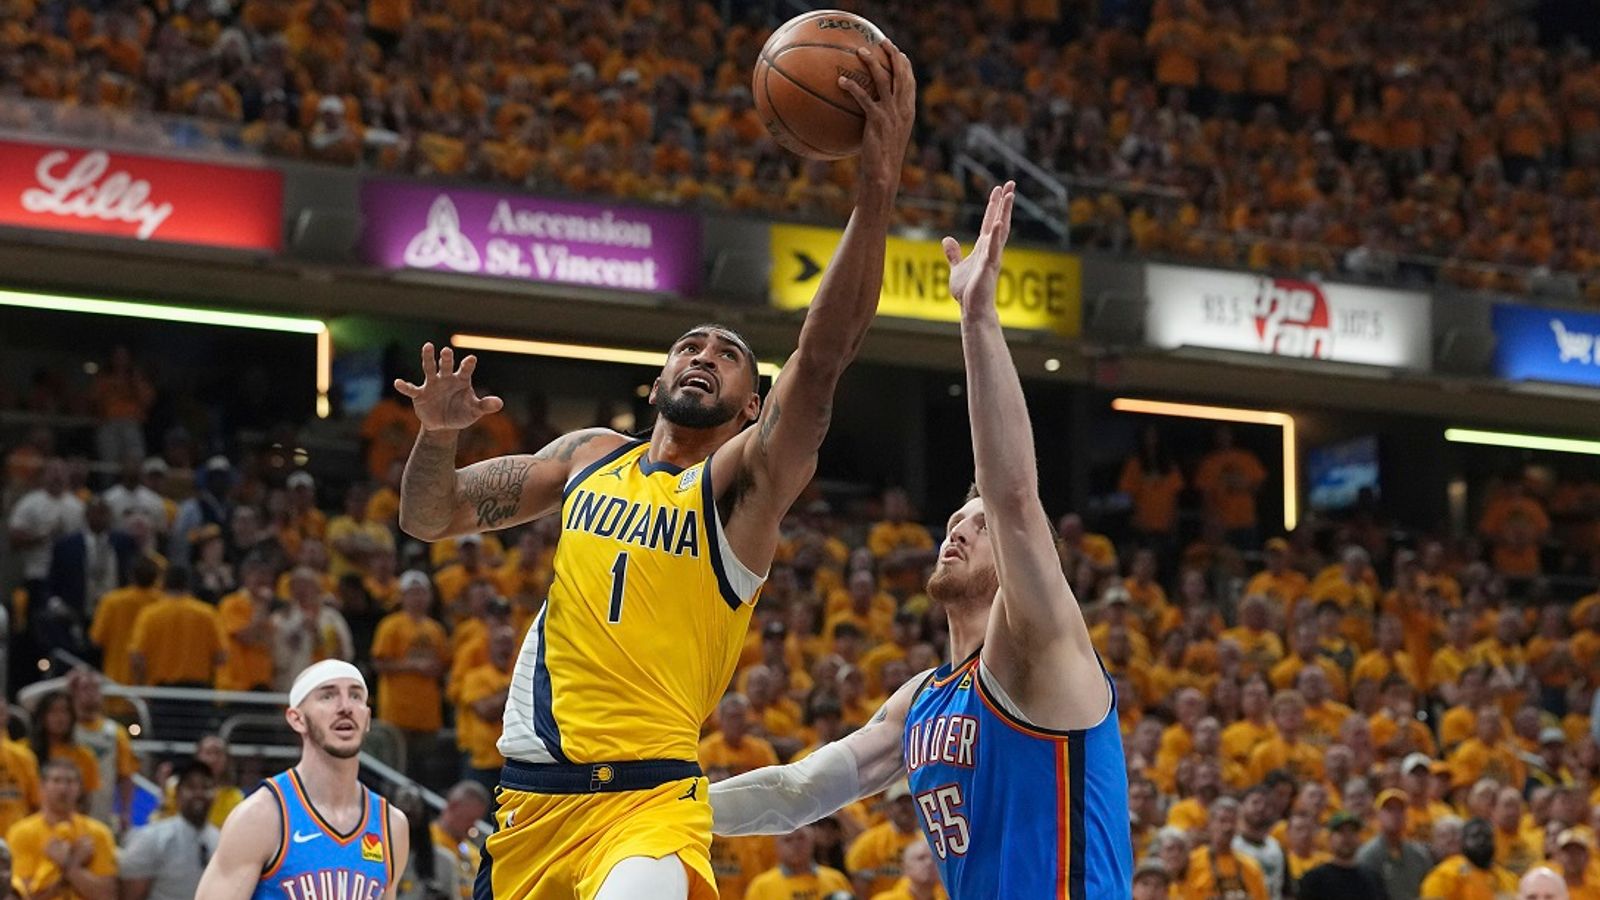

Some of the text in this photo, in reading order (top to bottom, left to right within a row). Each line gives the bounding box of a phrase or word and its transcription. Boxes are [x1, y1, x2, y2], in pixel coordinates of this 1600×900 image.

[20, 150, 173, 240] Lilly
[488, 199, 653, 249] Ascension
[485, 238, 660, 290] St. Vincent
[566, 490, 699, 558] INDIANA
[609, 552, 628, 623] 1
[908, 716, 977, 770] UNDER
[917, 784, 970, 860] 55
[281, 869, 386, 900] THUNDE
